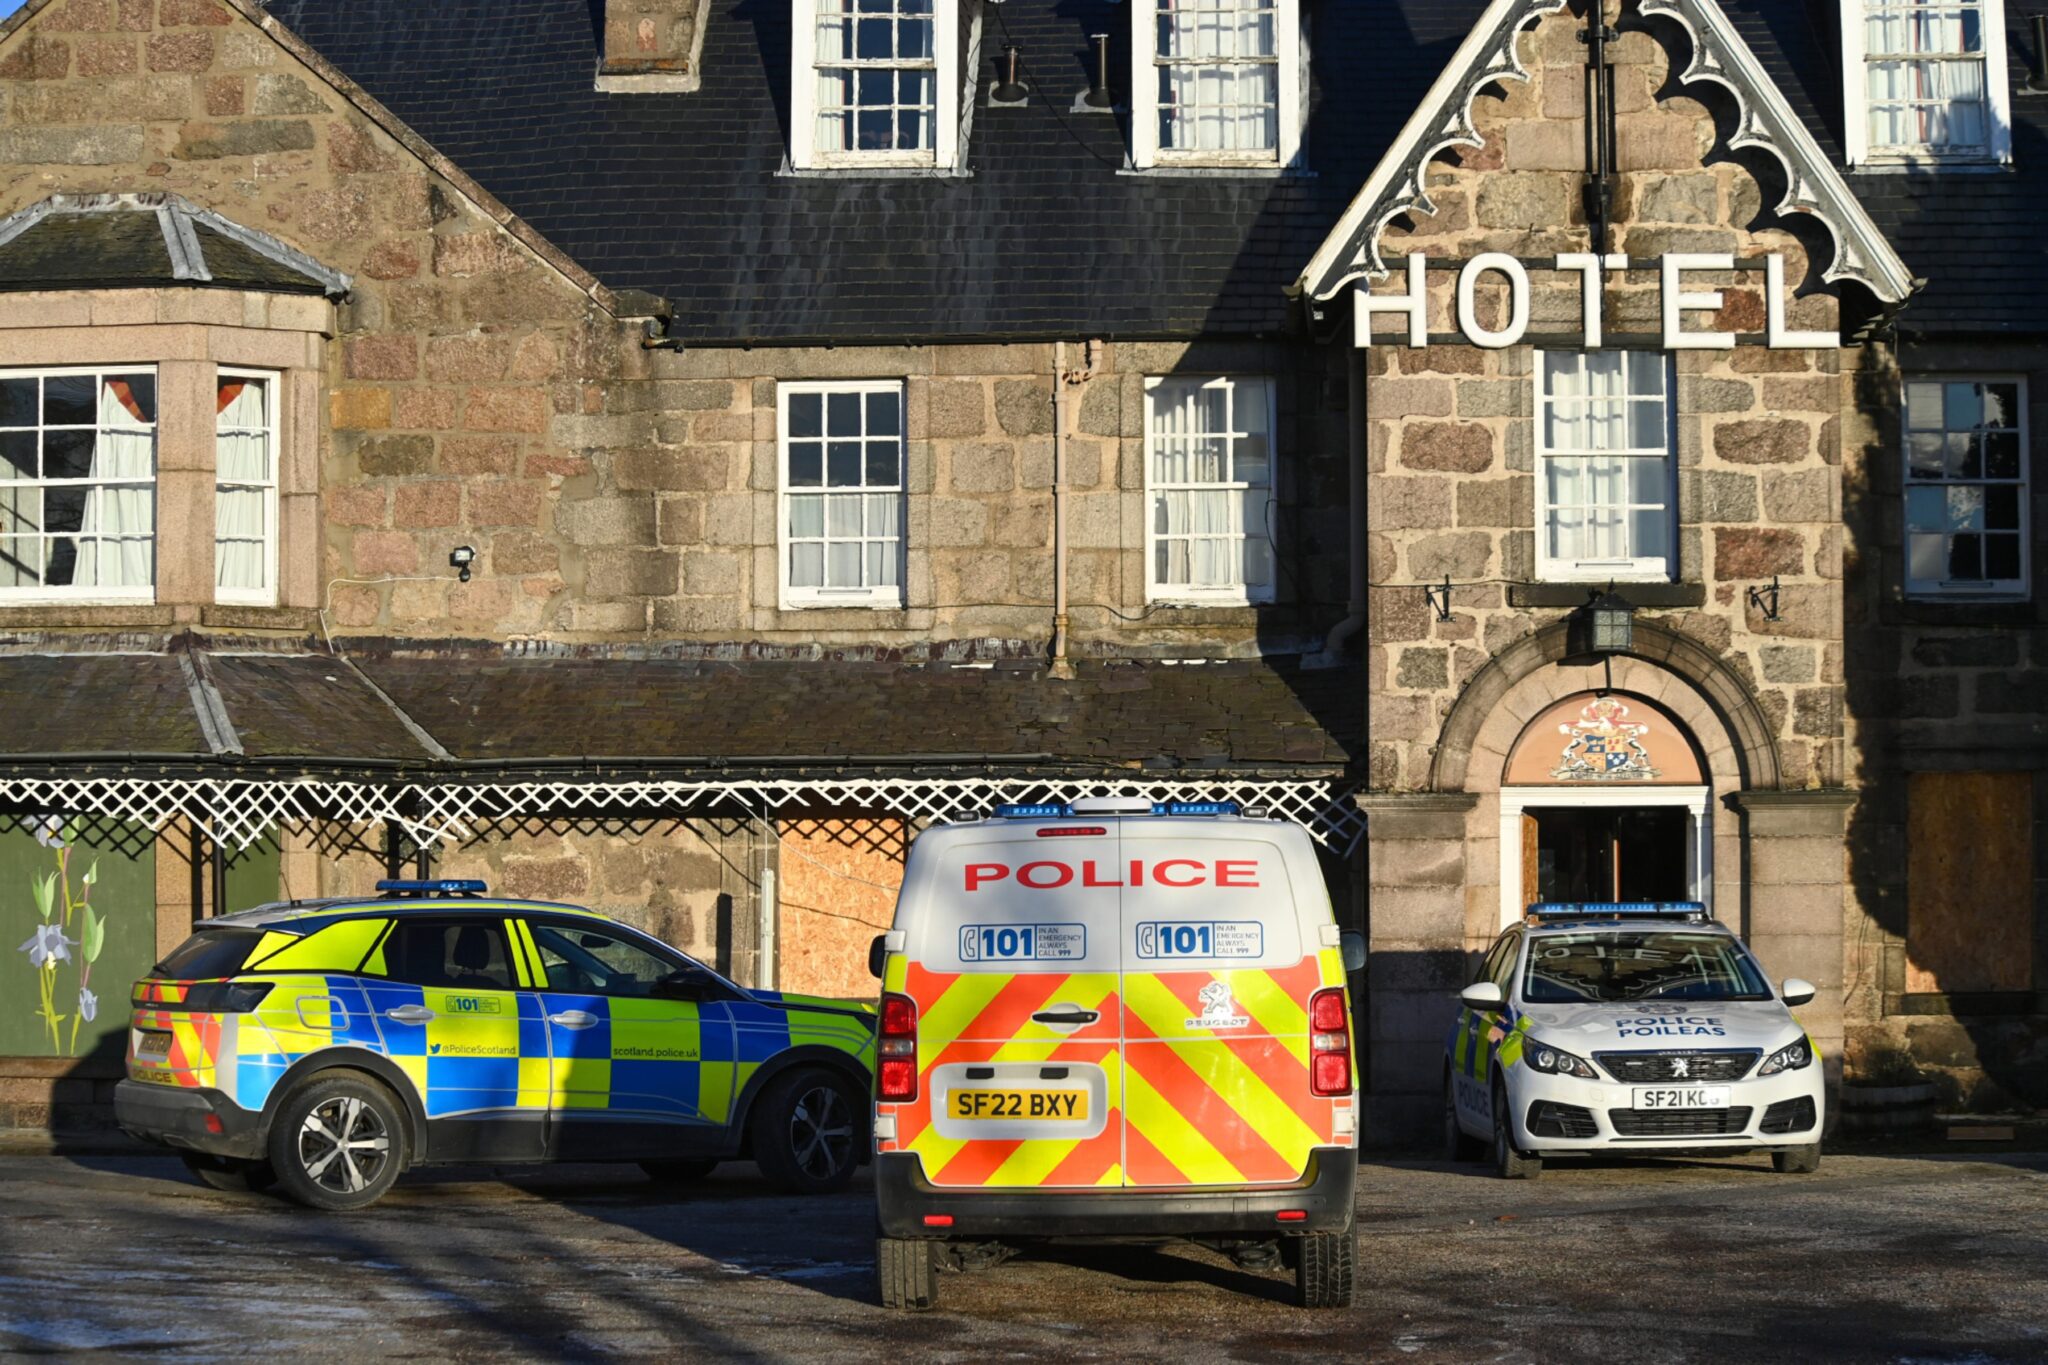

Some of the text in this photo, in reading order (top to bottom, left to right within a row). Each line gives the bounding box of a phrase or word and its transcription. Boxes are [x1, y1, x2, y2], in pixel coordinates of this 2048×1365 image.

[1354, 252, 1840, 349] HOTEL
[965, 859, 1259, 892] POLICE
[982, 927, 1032, 957] 101
[1160, 925, 1210, 954] 101
[1216, 932, 1259, 940] EMERGENCY
[1038, 949, 1072, 957] CALL 999
[456, 997, 478, 1011] 101
[1185, 1018, 1248, 1026] PEUGEOT
[1615, 1017, 1724, 1027] POLICE
[1618, 1026, 1726, 1038] POILEAS
[443, 1044, 516, 1055] @PoliceScotland
[613, 1046, 698, 1058] scotland.police.uk
[958, 1093, 1077, 1116] SF22 BXY
[1457, 1079, 1491, 1119] POLICE
[1644, 1090, 1682, 1107] SF21
